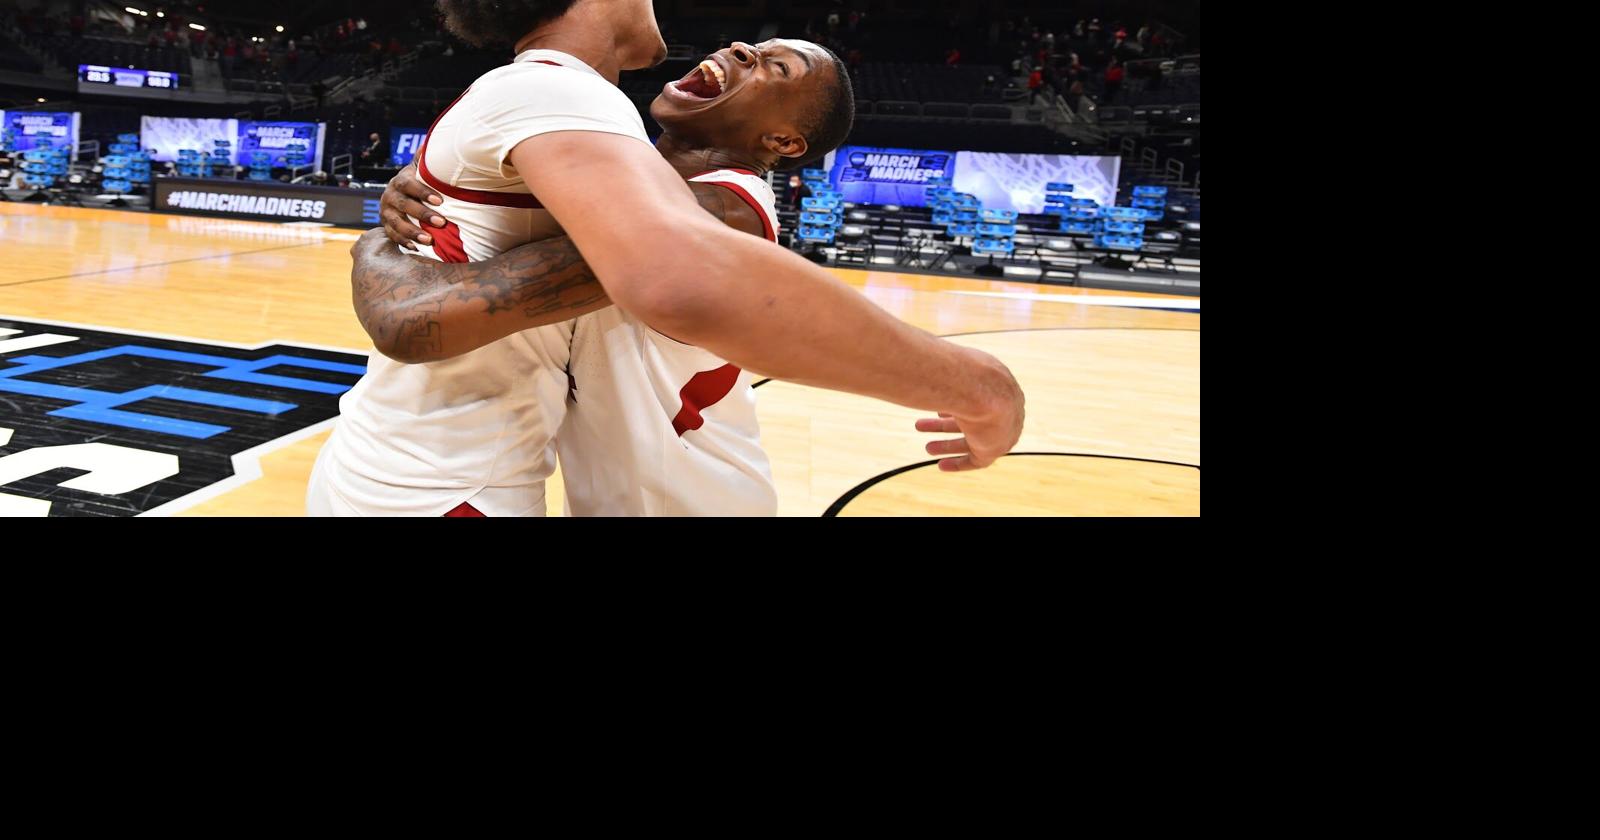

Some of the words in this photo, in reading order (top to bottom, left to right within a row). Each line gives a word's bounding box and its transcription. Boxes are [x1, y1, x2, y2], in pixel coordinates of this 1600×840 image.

[256, 126, 294, 137] MARCH
[397, 134, 427, 154] FI
[865, 154, 920, 168] MARCH
[167, 191, 326, 218] #MARCHMADNESS
